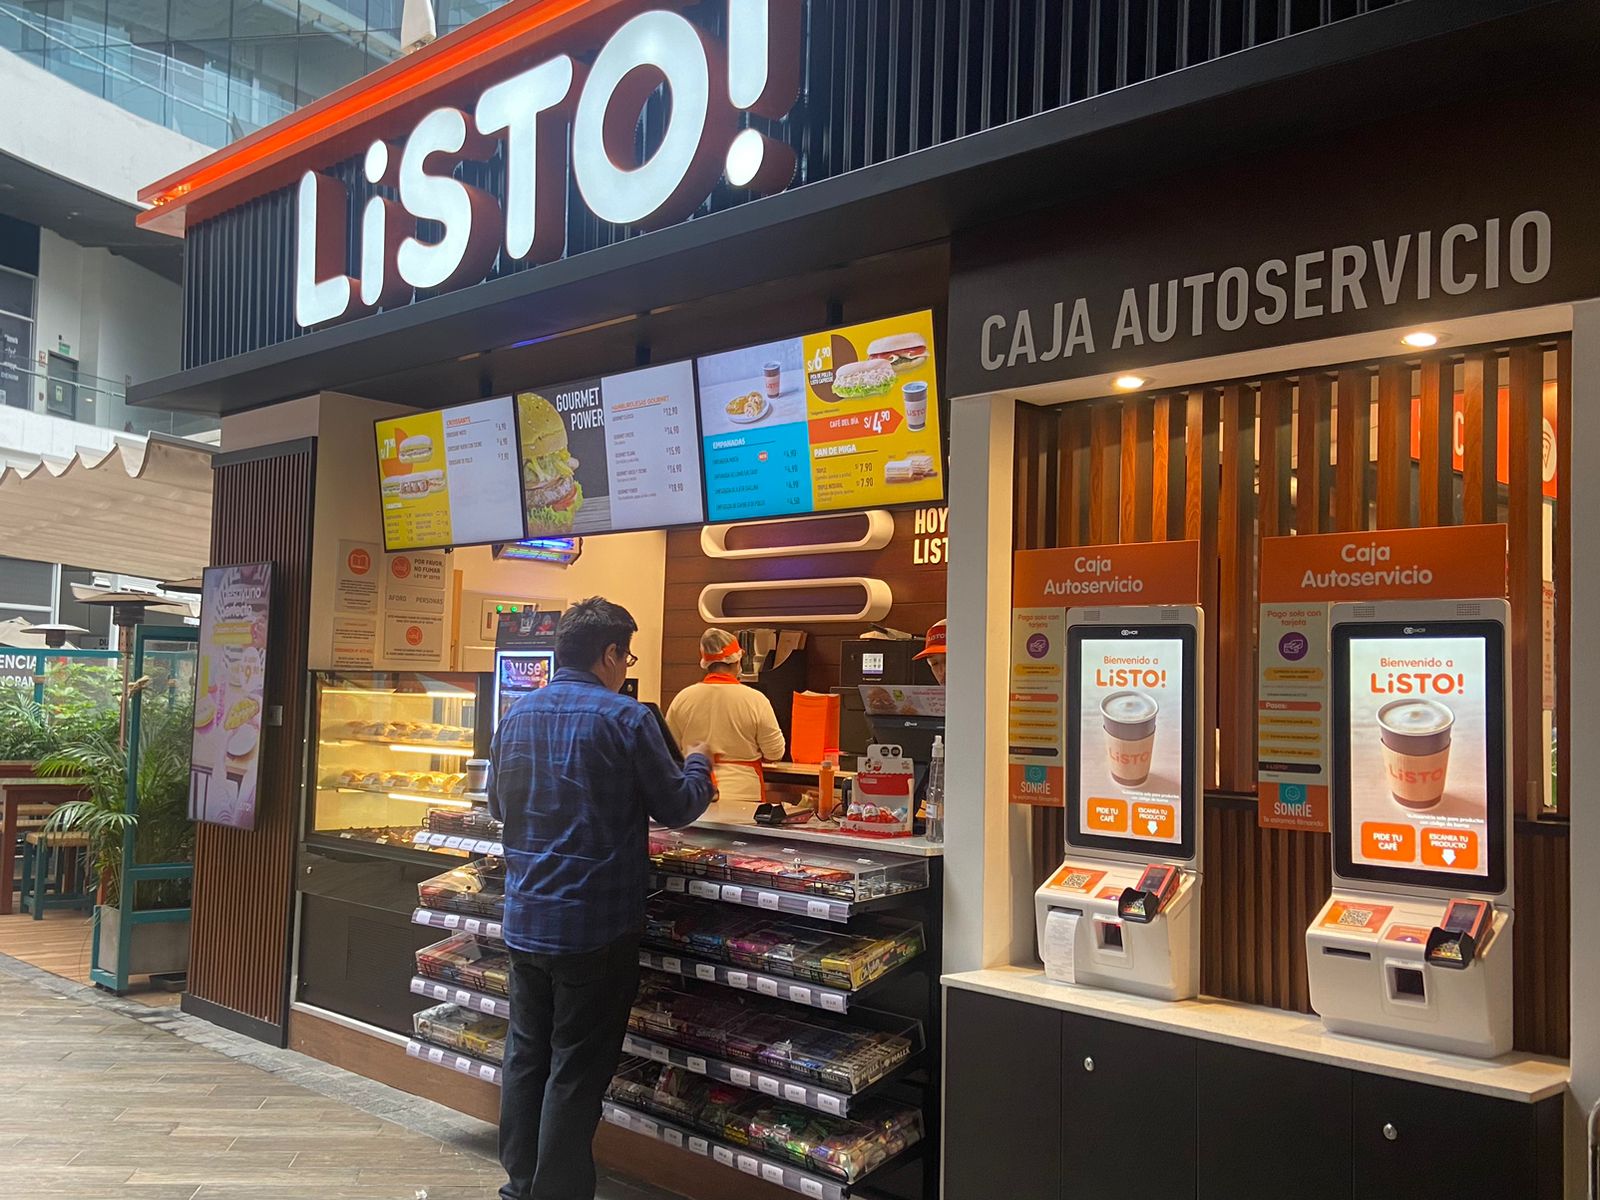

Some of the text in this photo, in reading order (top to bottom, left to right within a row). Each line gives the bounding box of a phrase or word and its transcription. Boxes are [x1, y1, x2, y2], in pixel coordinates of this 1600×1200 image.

[980, 210, 1552, 371] CAJA AUTOSERVICIO
[556, 387, 600, 414] GOURMET
[570, 409, 605, 431] POWER
[814, 444, 857, 458] PAN DE MIGA
[914, 507, 948, 535] HOY
[1340, 542, 1391, 567] Caja
[1074, 556, 1112, 576] Caja
[1043, 576, 1144, 596] Autoservicio
[1301, 566, 1433, 589] Autoservicio
[1267, 609, 1322, 621] Pago solo con
[1103, 655, 1159, 667] Bienvenido a
[1379, 656, 1454, 669] Bienvenido a
[1096, 668, 1168, 690] LiSTO!
[1370, 672, 1465, 697] LiSTO!
[1020, 781, 1051, 795] SONRÍE
[1096, 806, 1119, 816] PIDE TU
[1274, 800, 1312, 817] SONRÍE
[1139, 814, 1167, 822] PRODUCTO
[1373, 832, 1403, 843] PIDE TU
[1429, 832, 1469, 843] ESCANEA TU
[1431, 841, 1467, 850] PRODUCTO
